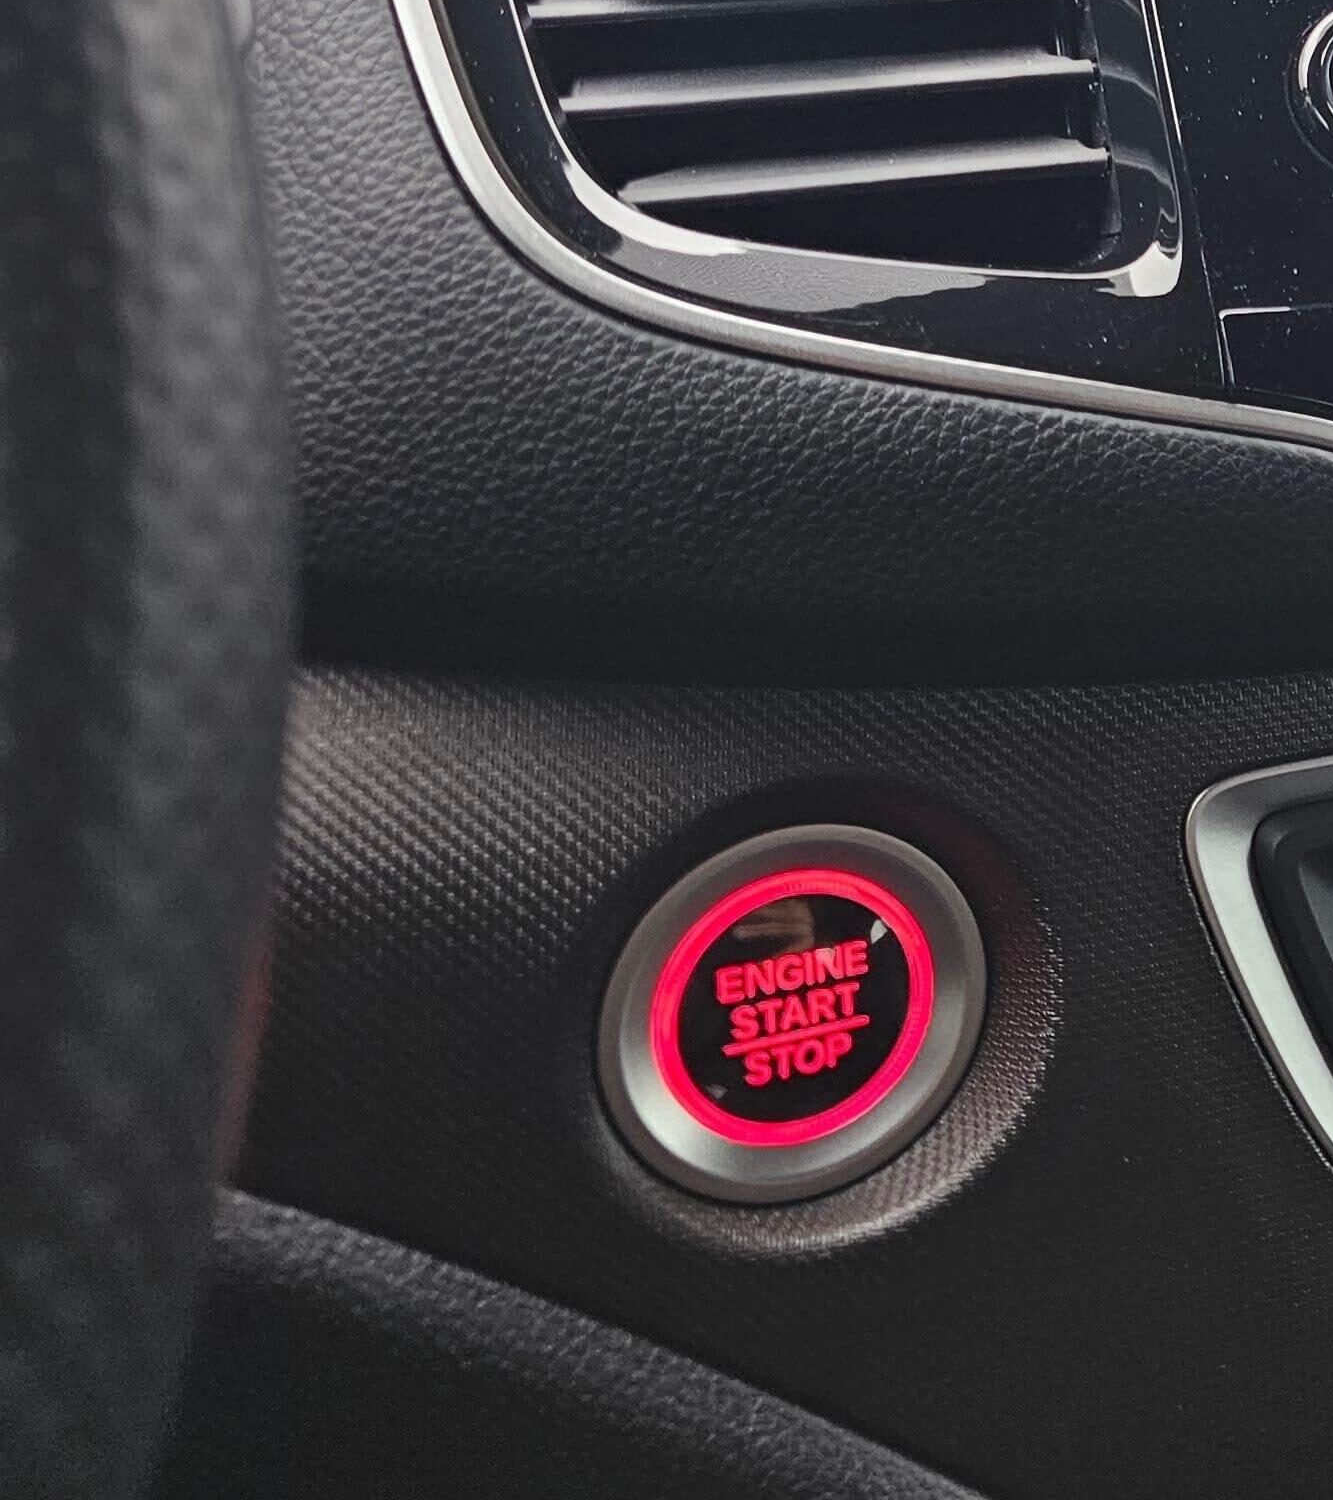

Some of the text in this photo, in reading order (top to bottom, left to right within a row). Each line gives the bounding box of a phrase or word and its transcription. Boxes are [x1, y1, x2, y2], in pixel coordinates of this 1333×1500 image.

[715, 938, 869, 1005] ENGINE
[730, 981, 860, 1041] START
[743, 1032, 852, 1086] STOP
